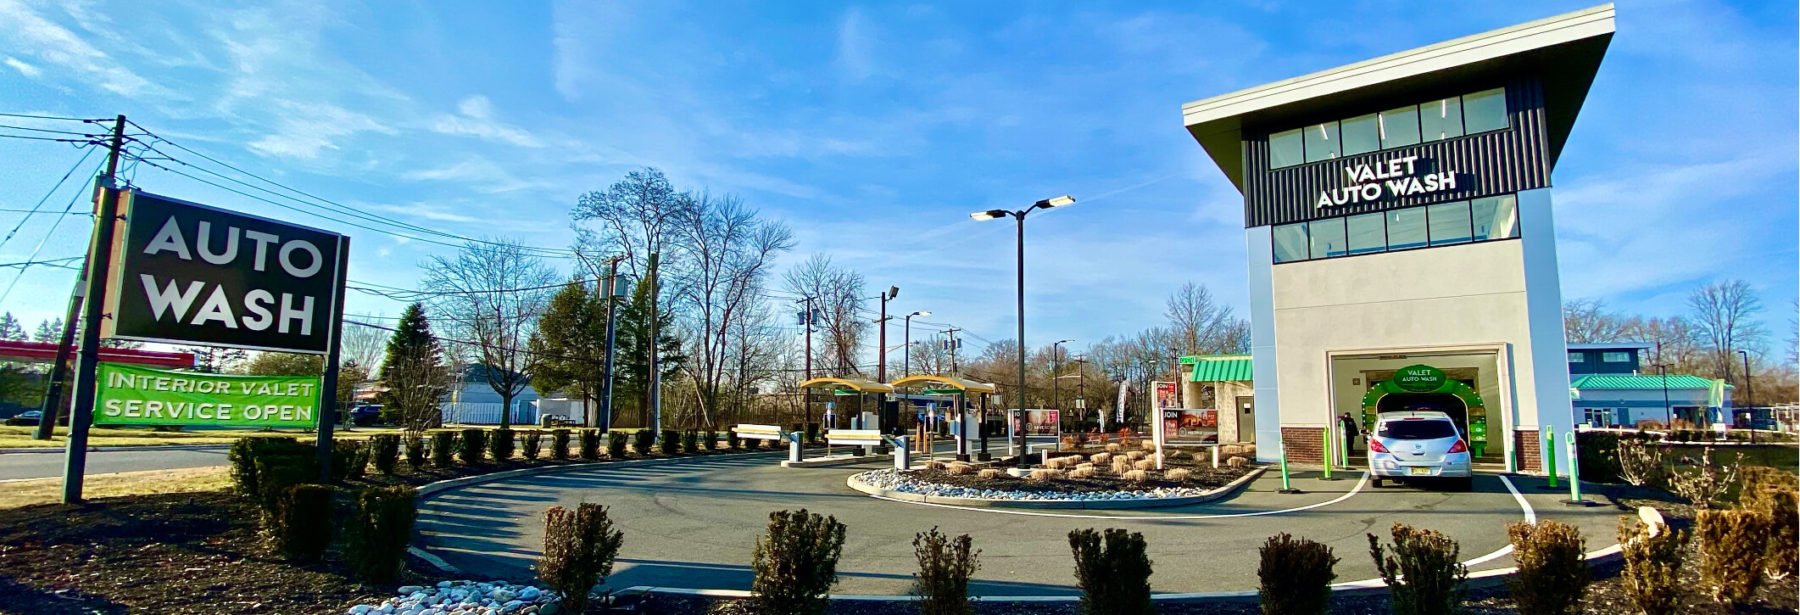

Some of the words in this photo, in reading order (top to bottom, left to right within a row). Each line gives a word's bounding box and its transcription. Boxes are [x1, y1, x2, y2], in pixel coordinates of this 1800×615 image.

[1345, 155, 1418, 183] VALET
[1317, 183, 1382, 208] AUTO
[1386, 170, 1456, 197] WASH
[143, 215, 323, 278] AUTO
[139, 273, 315, 336] WASH
[108, 372, 231, 395] INTERIOR
[241, 381, 315, 397] VALET
[105, 398, 233, 420] SERVICE
[243, 404, 312, 421] OPEN
